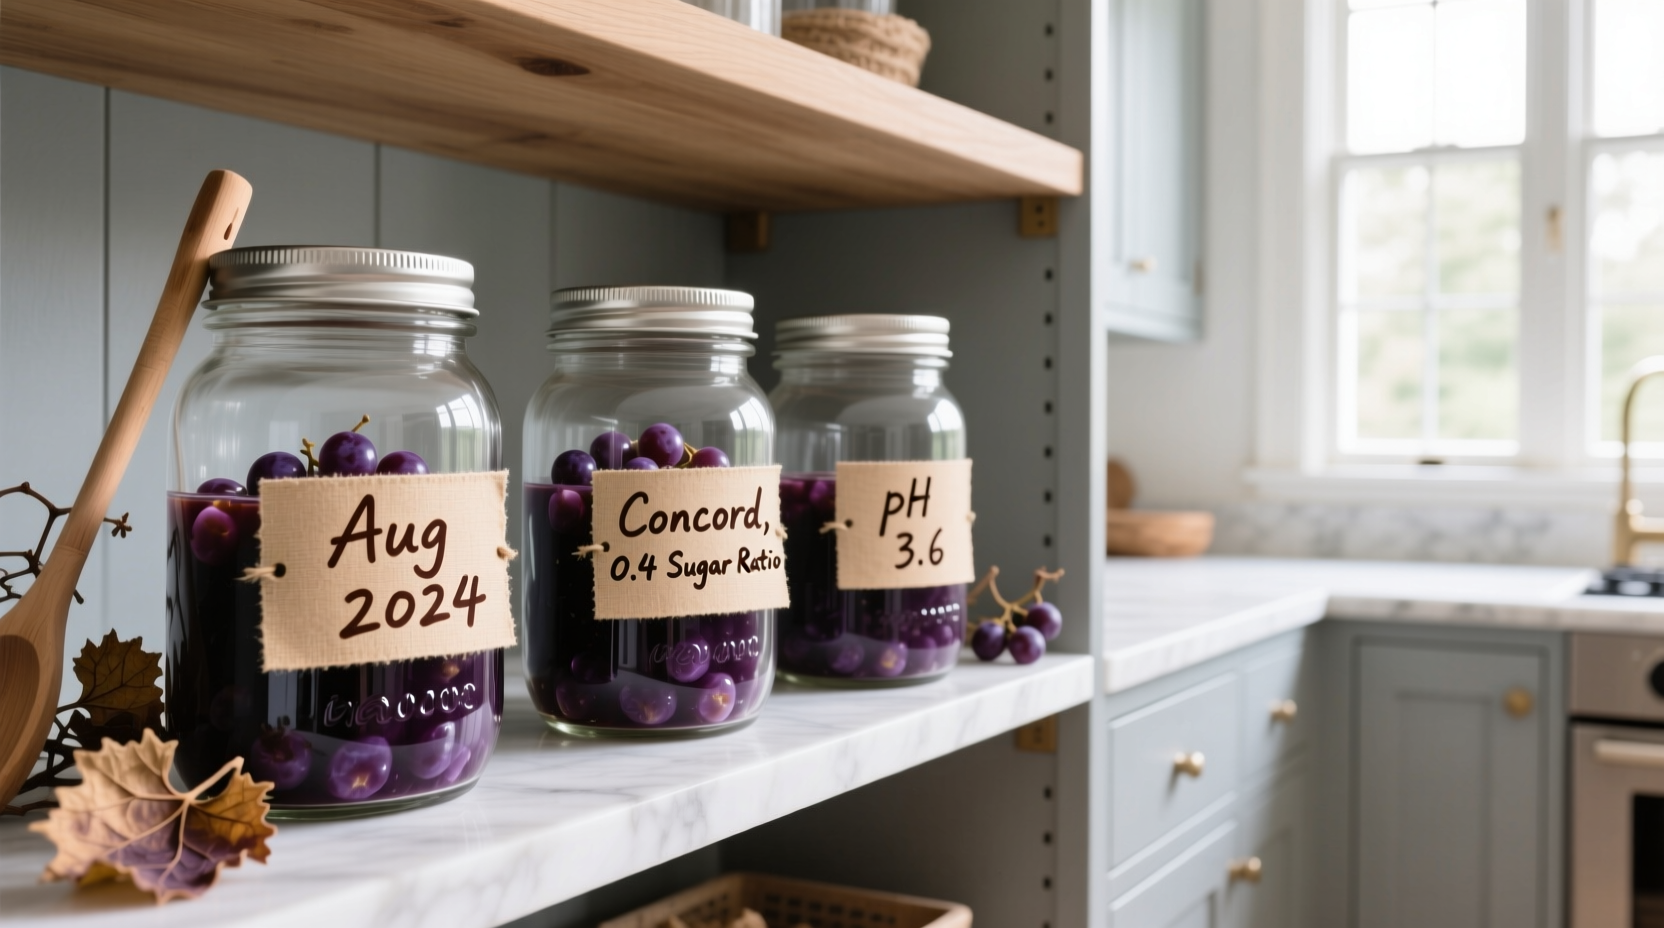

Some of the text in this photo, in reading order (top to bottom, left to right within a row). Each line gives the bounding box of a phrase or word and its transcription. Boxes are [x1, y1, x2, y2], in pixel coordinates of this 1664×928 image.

[618, 485, 771, 538] Concord,
[878, 476, 932, 538] pH
[327, 493, 448, 580] Aug
[894, 527, 944, 570] 3.6
[609, 546, 782, 591] 0.4 Sugar Ratio
[338, 574, 488, 640] 2024
